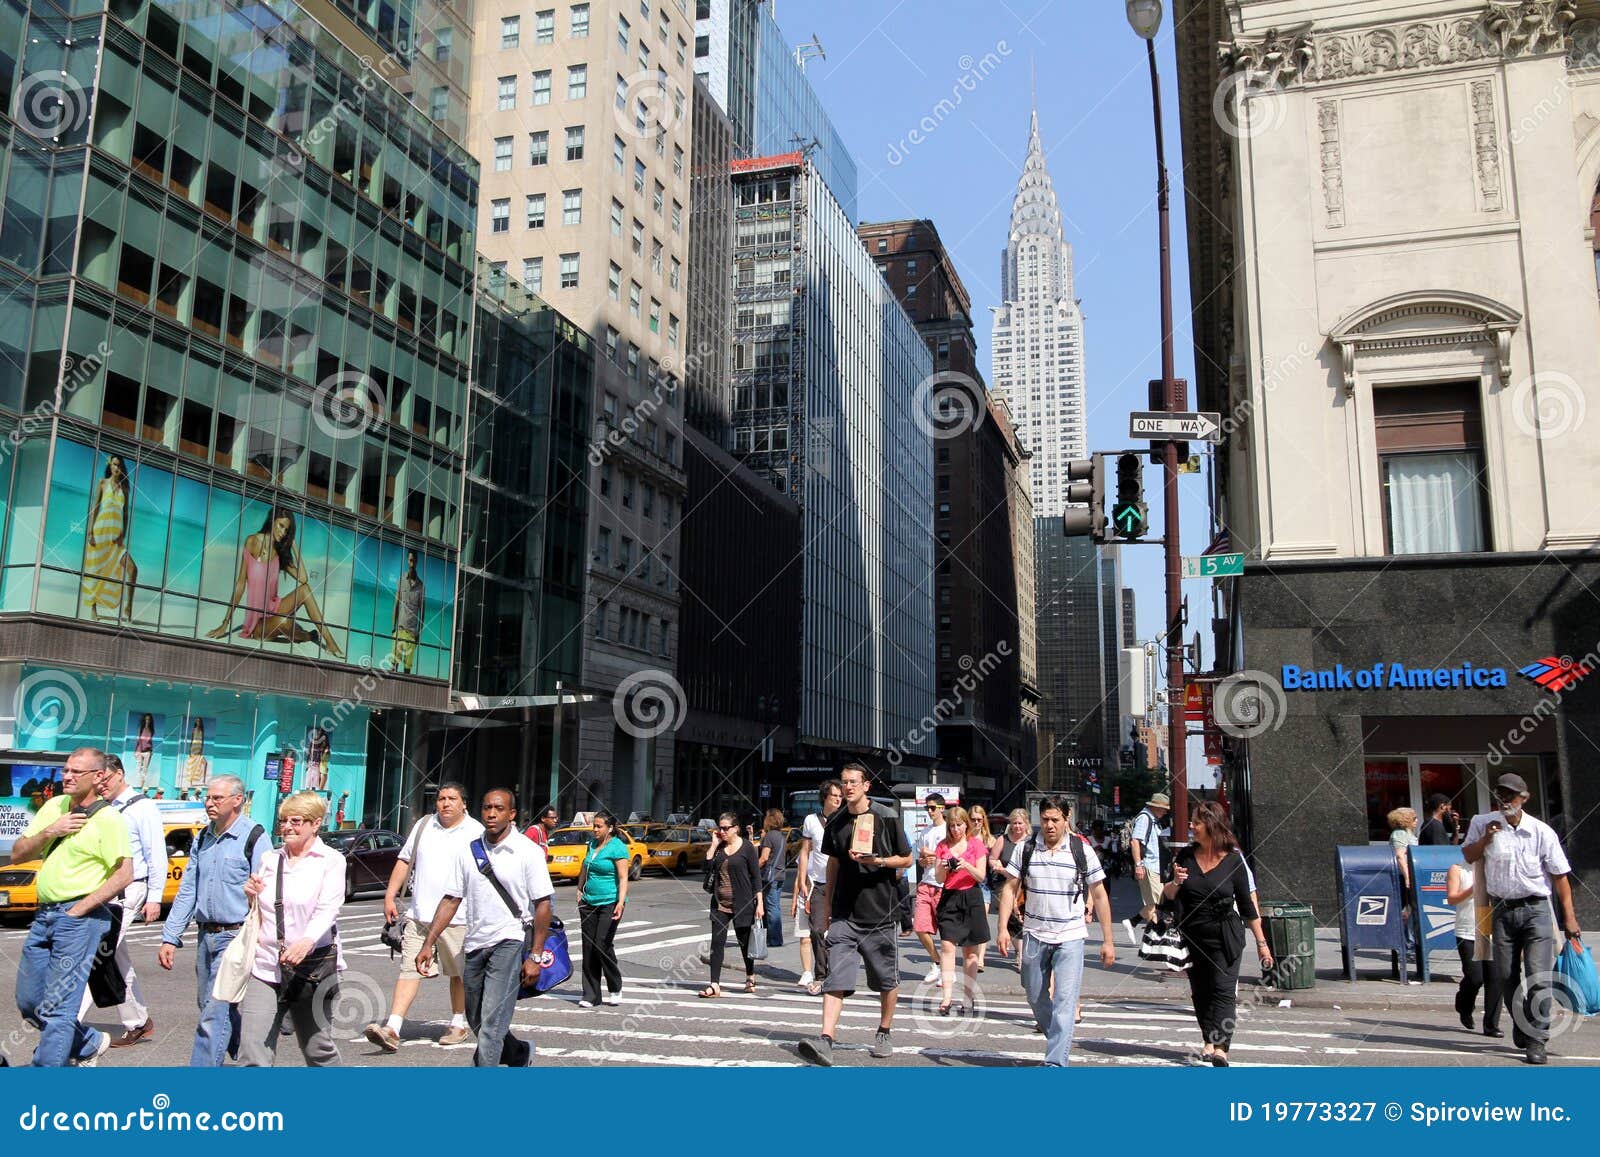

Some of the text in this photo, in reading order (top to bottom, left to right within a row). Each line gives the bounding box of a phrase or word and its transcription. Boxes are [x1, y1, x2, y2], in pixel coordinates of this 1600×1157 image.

[1137, 420, 1207, 432] ONE WAY
[1207, 558, 1218, 574] 5
[1222, 556, 1237, 566] AV
[1282, 662, 1508, 690] Bank of America
[1067, 758, 1103, 768] HYATT
